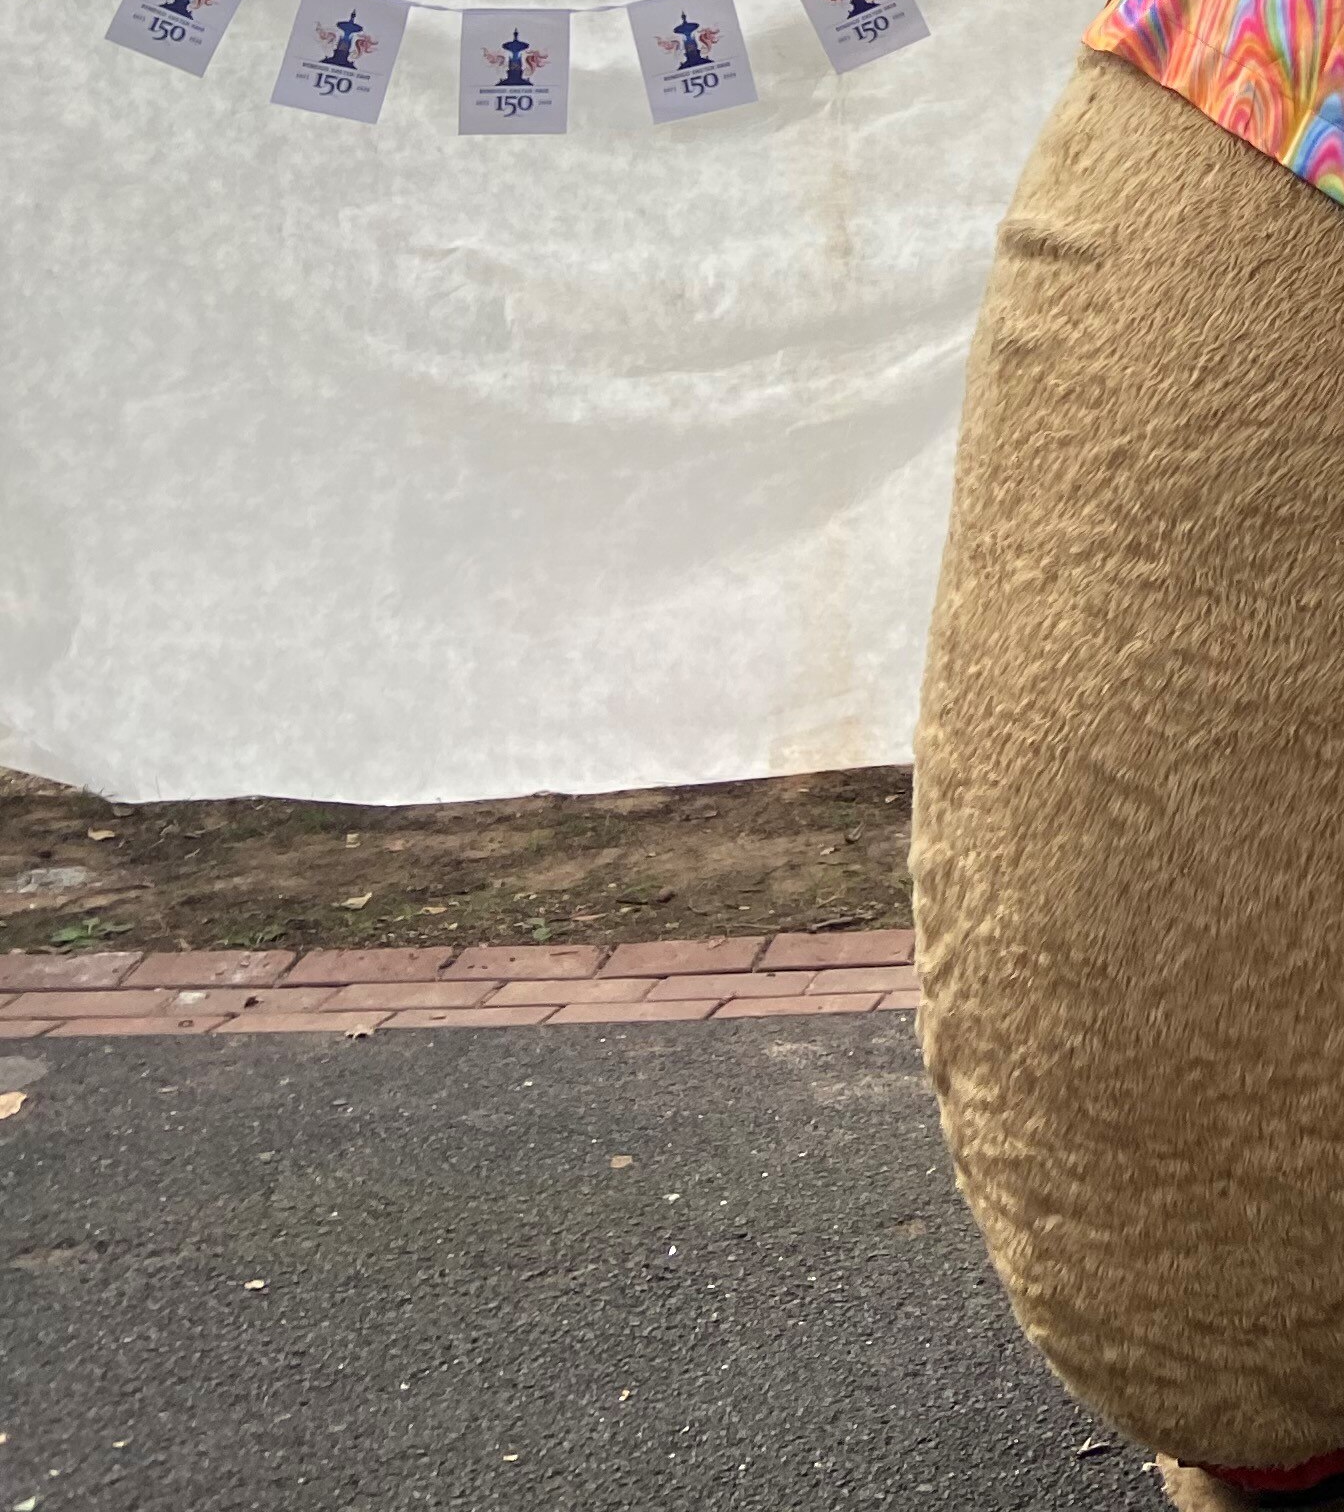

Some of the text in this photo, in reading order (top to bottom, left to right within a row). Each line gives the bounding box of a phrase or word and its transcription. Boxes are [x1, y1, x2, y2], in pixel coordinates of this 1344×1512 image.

[148, 16, 186, 42] 150
[852, 16, 889, 43] 150
[313, 73, 353, 96] 150
[681, 73, 719, 98] 150
[495, 95, 533, 117] 150
